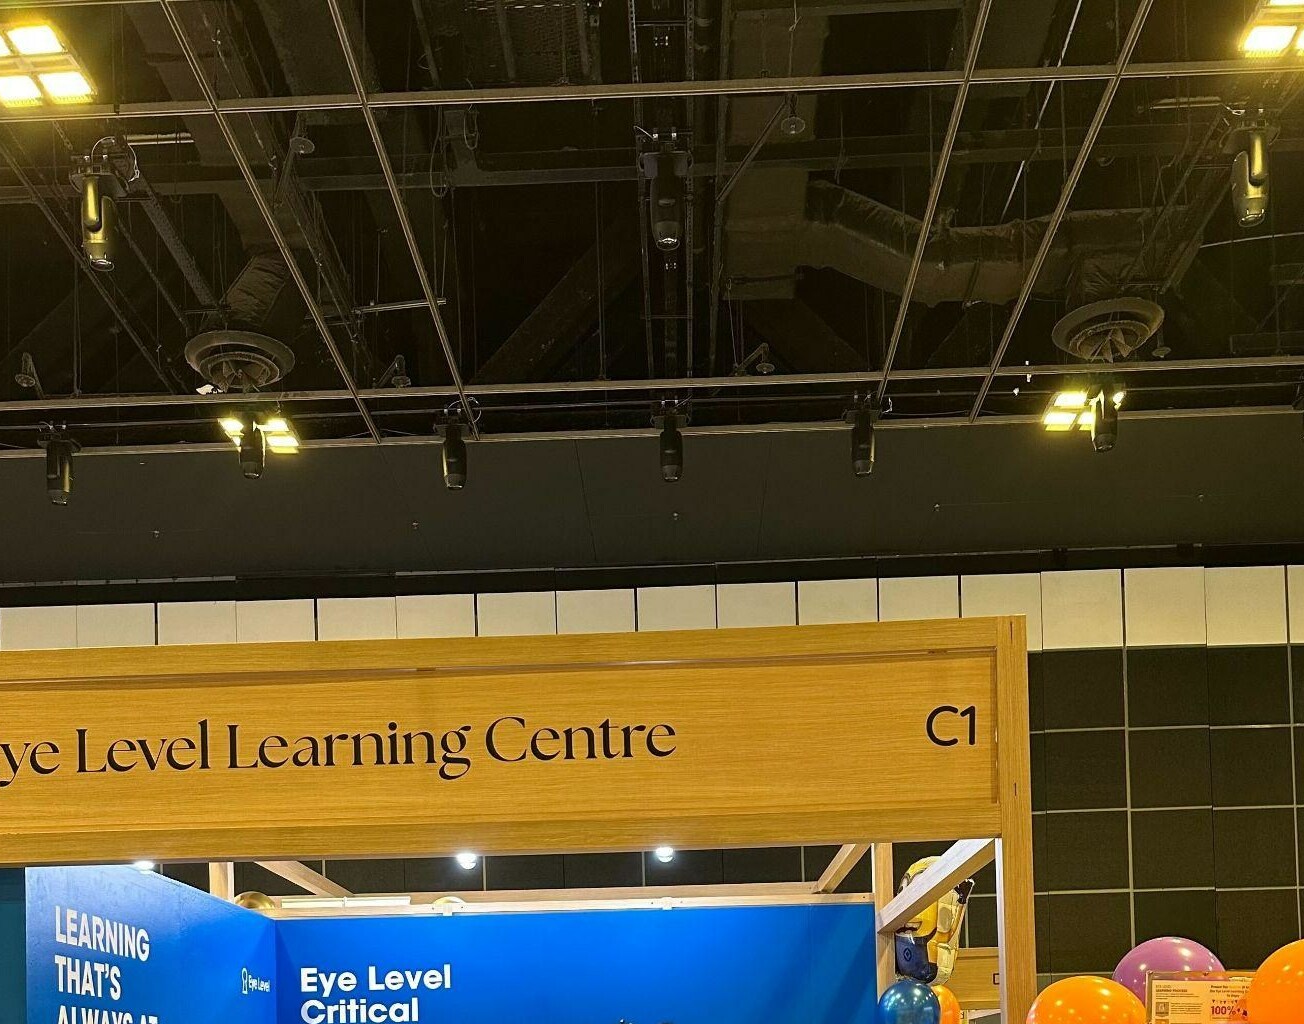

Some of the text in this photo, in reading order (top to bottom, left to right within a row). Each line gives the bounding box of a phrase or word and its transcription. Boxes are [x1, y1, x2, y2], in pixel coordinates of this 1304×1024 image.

[925, 705, 977, 746] C1
[76, 719, 210, 774] Level
[227, 721, 471, 780] Learning
[485, 716, 676, 762] Centre
[55, 905, 150, 961] LEARNING
[54, 954, 121, 1001] THAT'S
[257, 976, 271, 993] Level
[300, 963, 451, 997] Eye Level
[300, 997, 419, 1024] Critical
[1211, 1005, 1237, 1016] 100%
